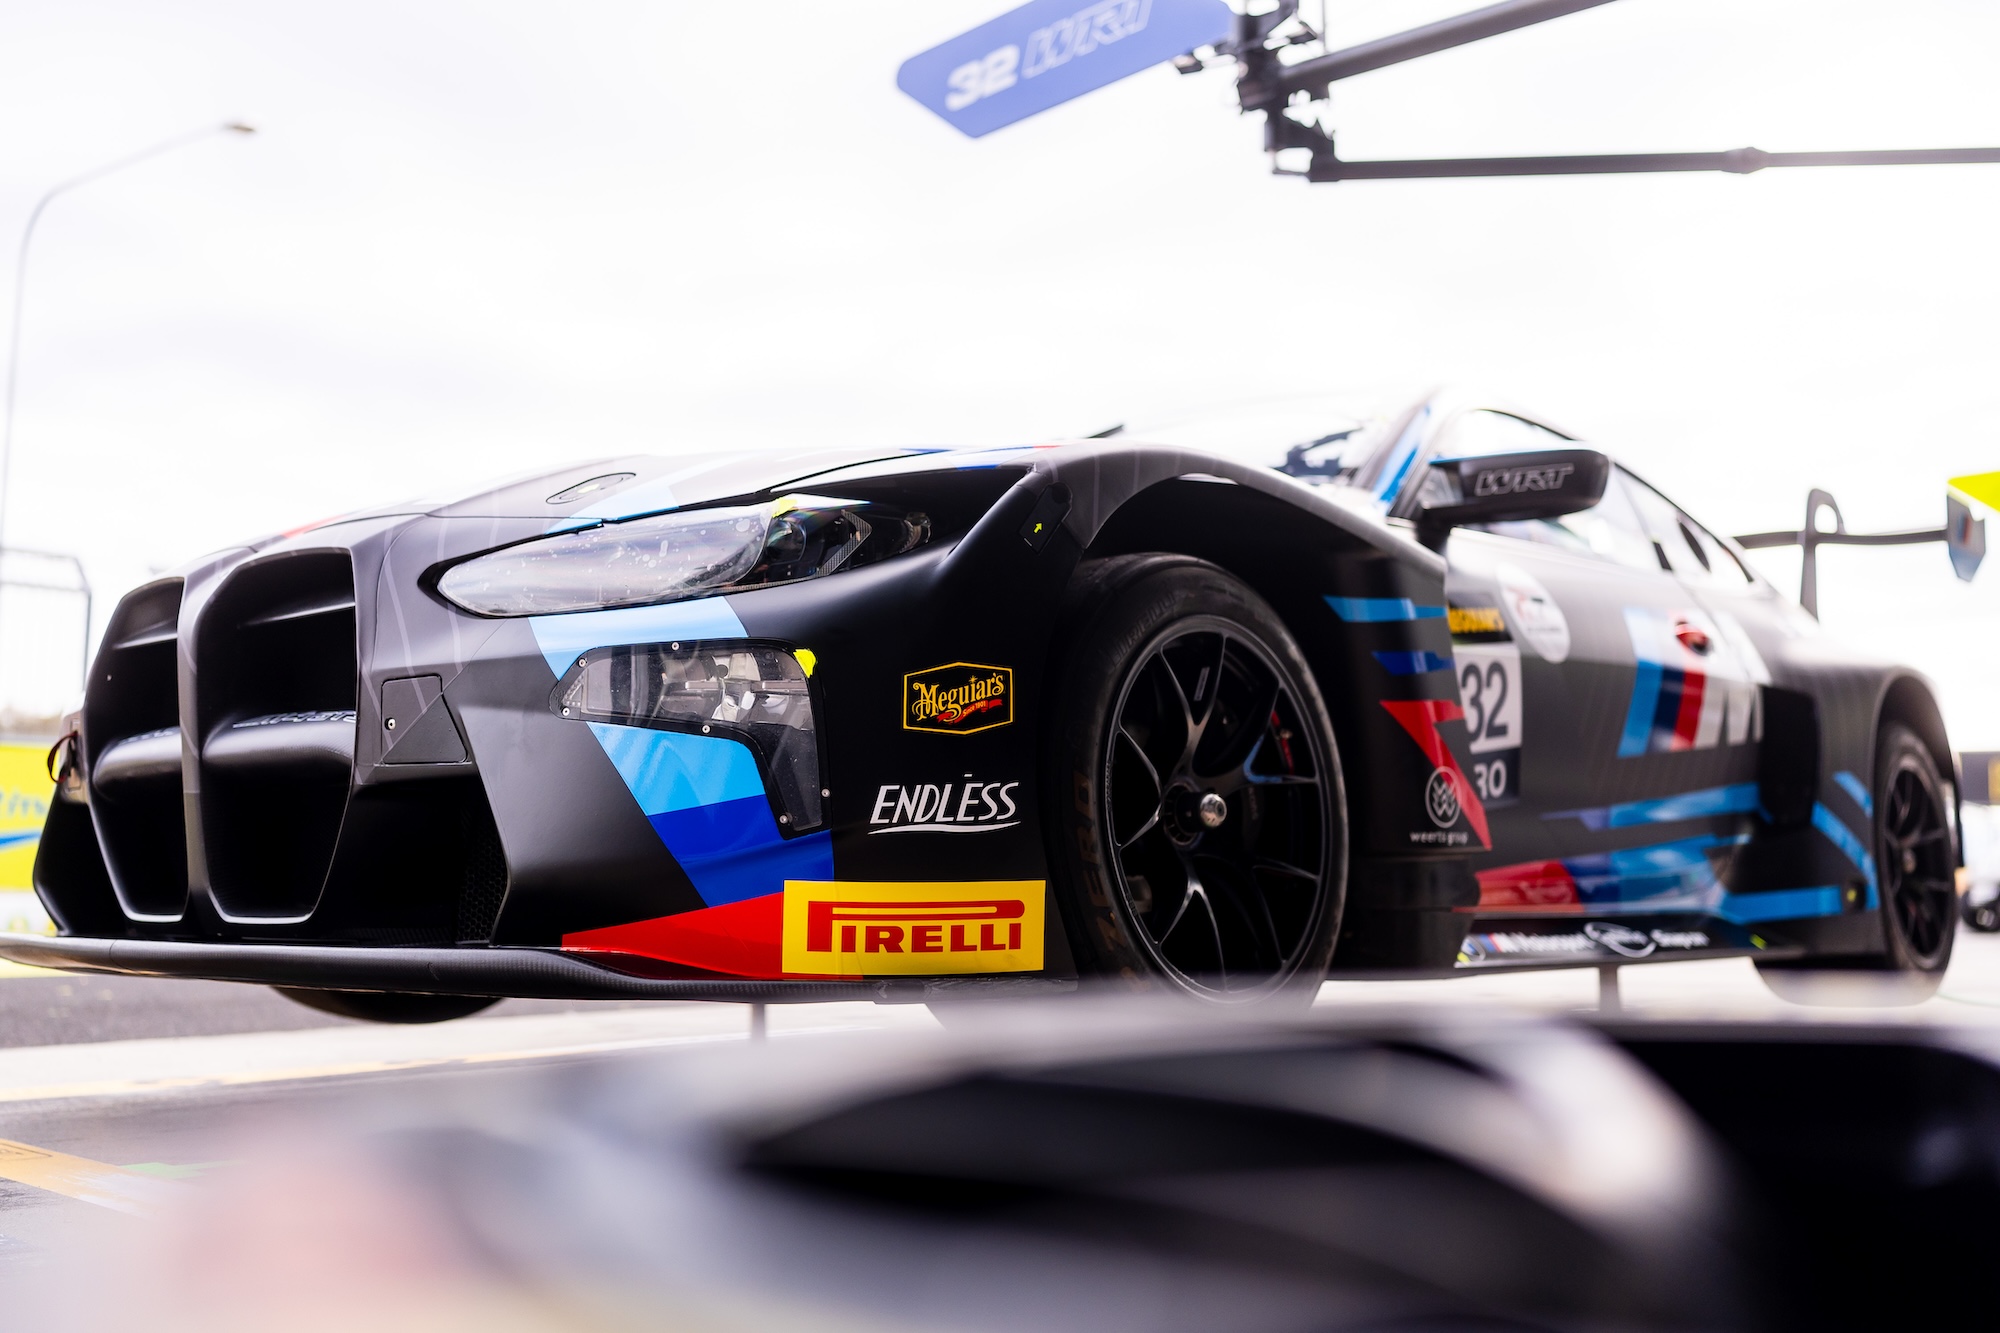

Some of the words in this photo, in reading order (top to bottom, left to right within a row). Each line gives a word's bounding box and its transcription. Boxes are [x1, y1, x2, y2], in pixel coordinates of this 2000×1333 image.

[944, 43, 1021, 112] 32
[1474, 463, 1575, 496] WRT
[912, 673, 1005, 722] Meguiar's
[1461, 662, 1509, 743] 32
[806, 899, 1025, 953] PIRELLI
